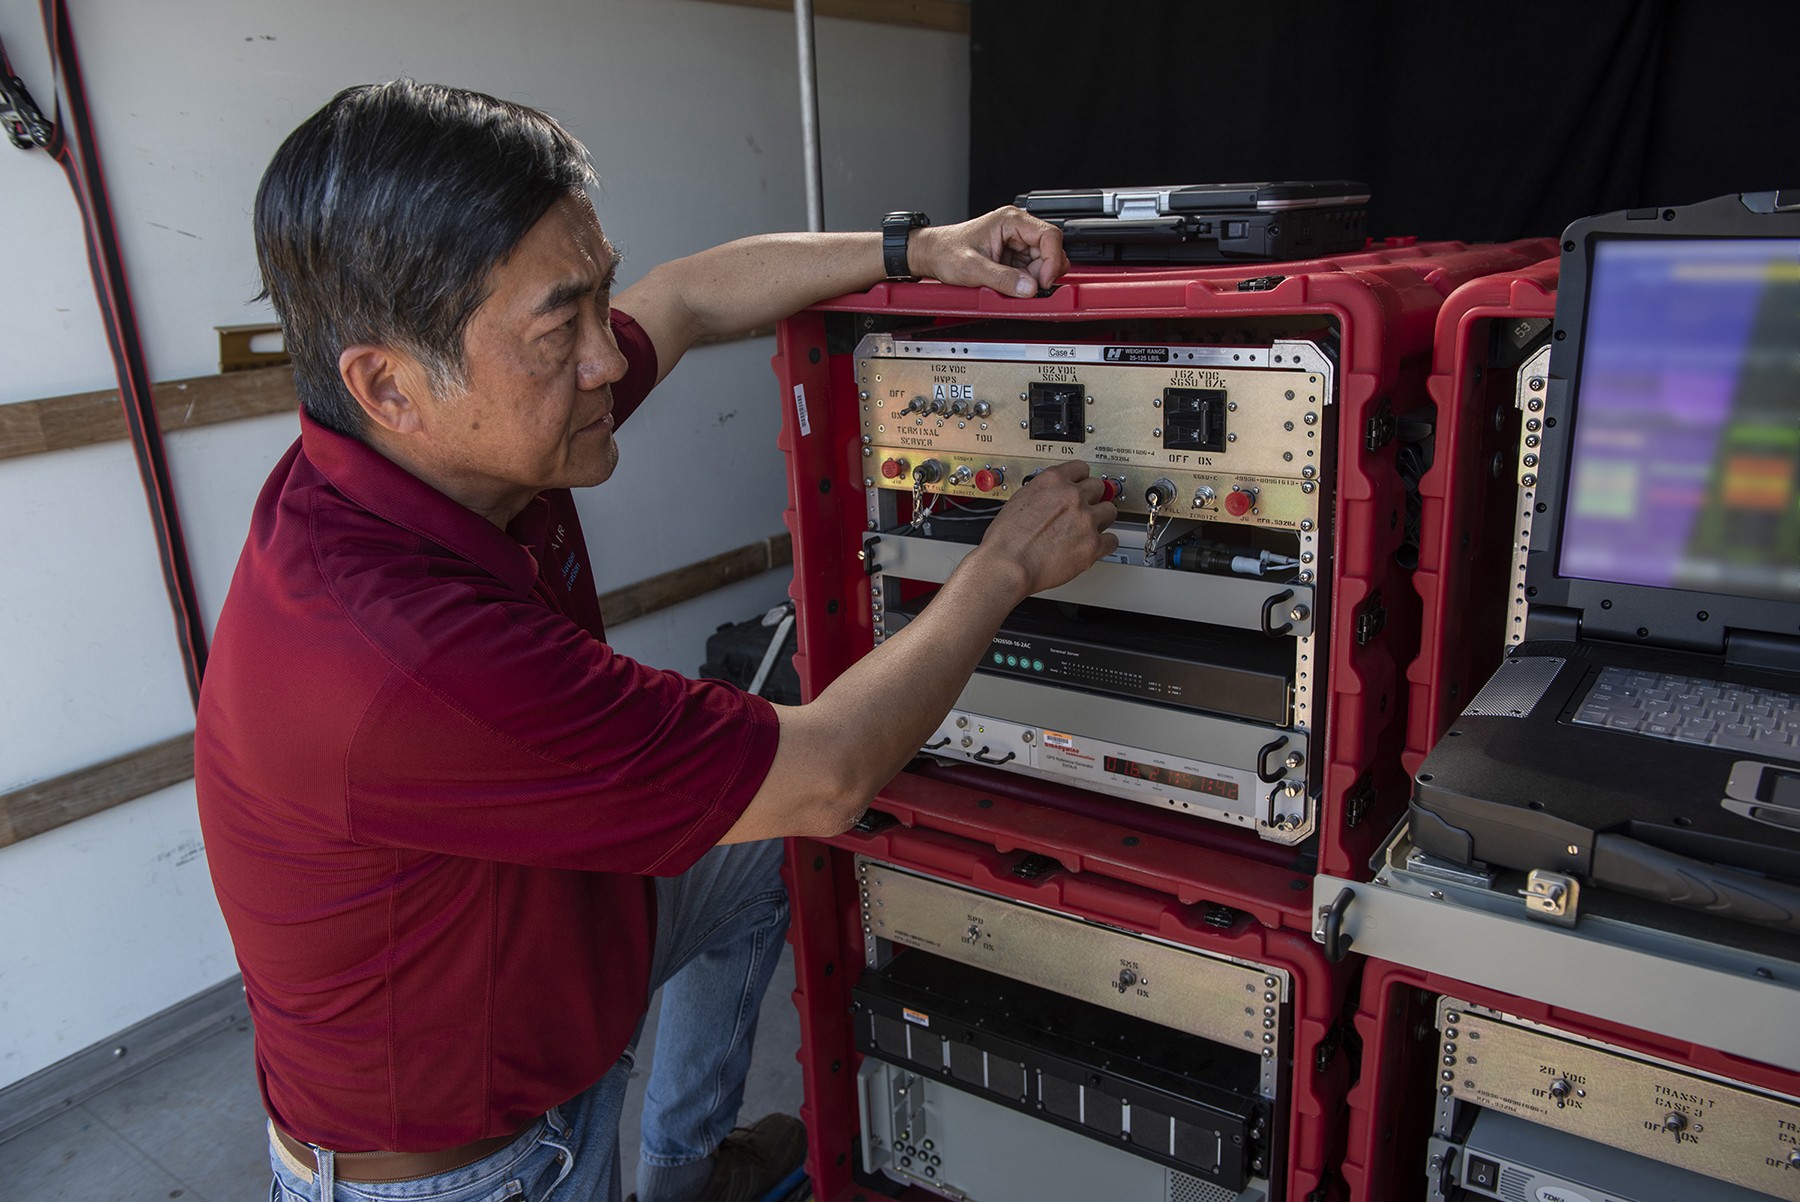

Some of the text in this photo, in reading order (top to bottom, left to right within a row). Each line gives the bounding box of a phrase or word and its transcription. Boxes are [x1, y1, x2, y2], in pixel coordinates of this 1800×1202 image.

[1050, 348, 1068, 356] Case
[931, 364, 966, 373] 162 VDC
[1038, 366, 1076, 374] 162 VDC
[1042, 374, 1067, 382] SGSU
[1174, 370, 1219, 380] 162 VDC
[1170, 378, 1226, 388] SGSU B/E
[889, 390, 906, 398] OFF
[935, 385, 944, 398] A
[950, 385, 972, 399] B/E
[897, 426, 939, 436] TERMINAL
[900, 437, 933, 446] SERVER
[975, 434, 992, 442] TDU
[1036, 444, 1074, 454] OFF ON
[1169, 454, 1212, 465] OFF ON
[983, 942, 994, 951] ON
[1137, 988, 1149, 998] ON
[1540, 1065, 1586, 1084] 28 VDC
[1532, 1088, 1582, 1109] OFF ON
[1655, 1085, 1715, 1108] TRANSIT
[1655, 1097, 1702, 1117] CASE 3
[1644, 1121, 1698, 1144] OFF ON
[1778, 1133, 1800, 1145] CA
[1765, 1157, 1793, 1171] OFF
